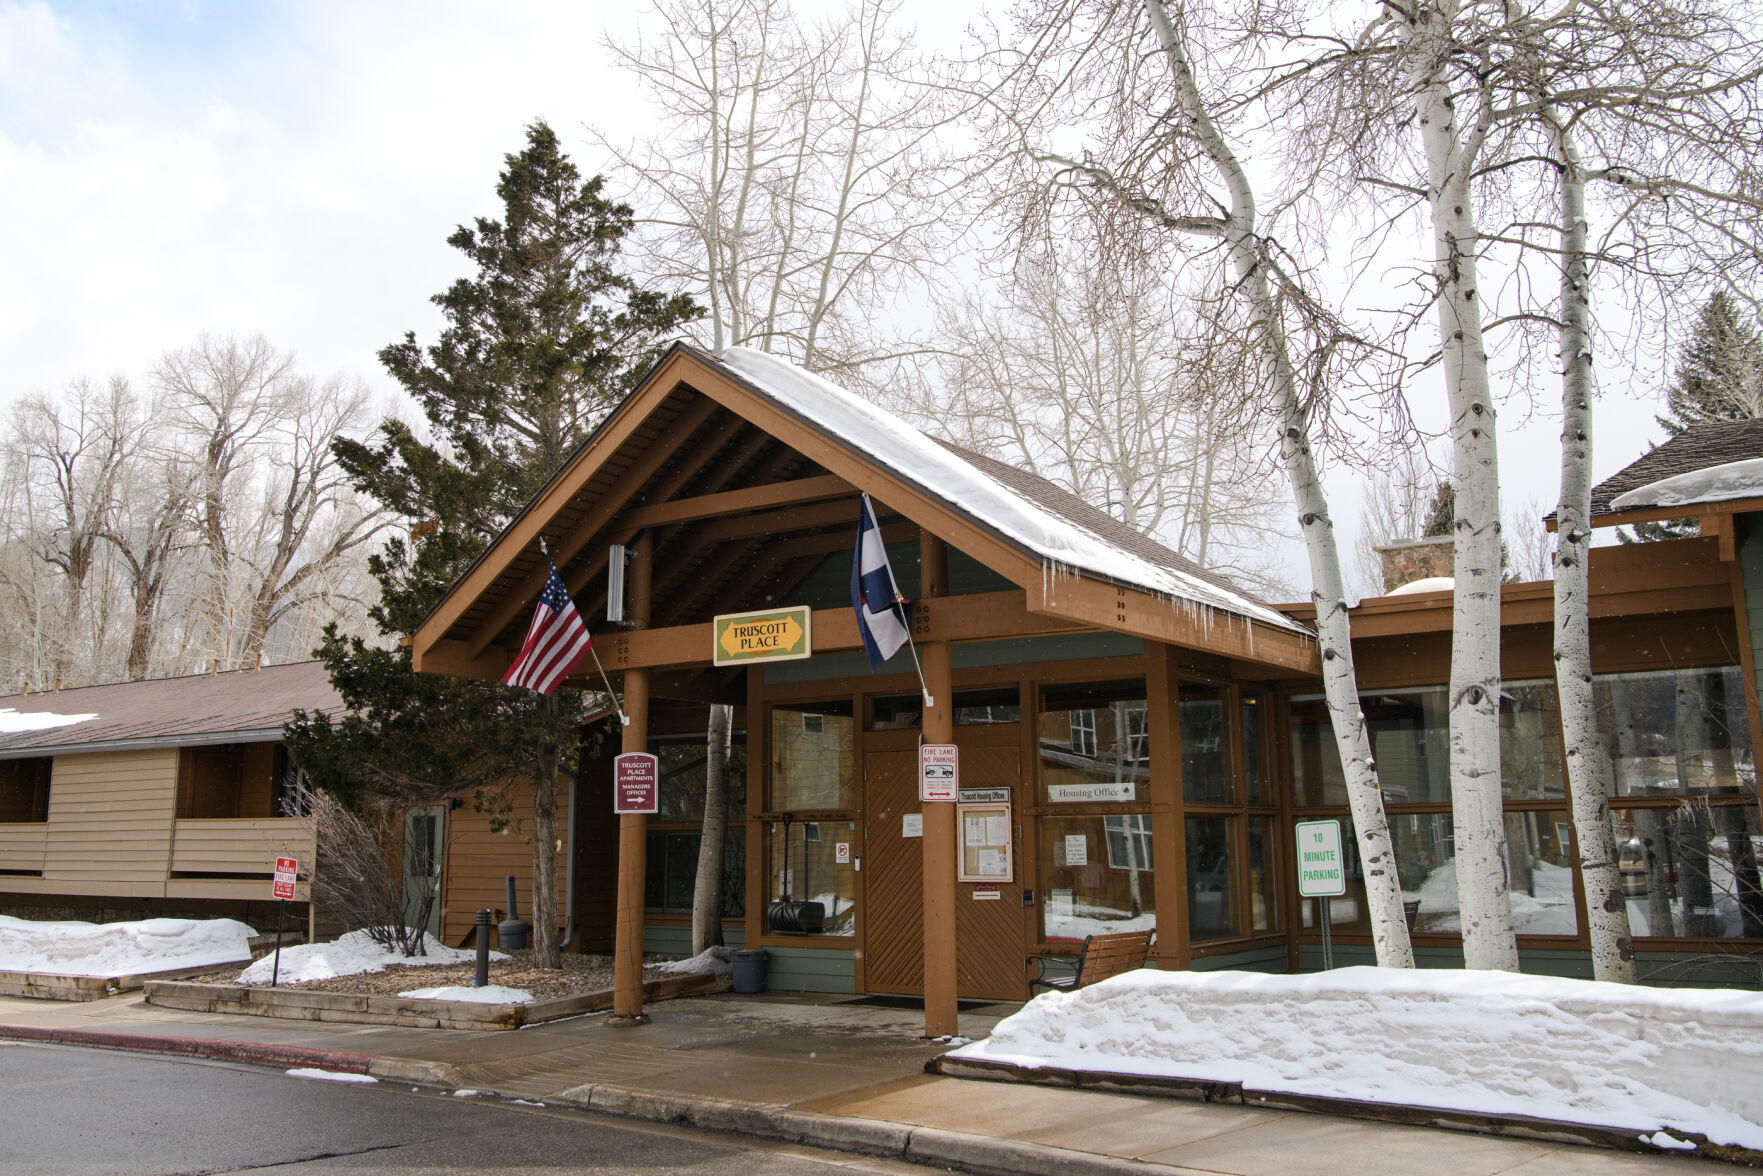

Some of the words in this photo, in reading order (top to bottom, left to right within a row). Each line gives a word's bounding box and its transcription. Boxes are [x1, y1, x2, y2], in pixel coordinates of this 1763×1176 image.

[733, 622, 788, 638] TRUSCOTT
[741, 635, 780, 649] PLACE
[961, 792, 976, 800] Truscott
[977, 791, 992, 801] Housing
[992, 791, 1005, 800] Offices
[1060, 789, 1092, 799] Housing
[1094, 788, 1119, 797] Office
[1313, 832, 1323, 843] 10
[1304, 850, 1336, 862] MINUTE
[1303, 869, 1339, 880] PARKING
